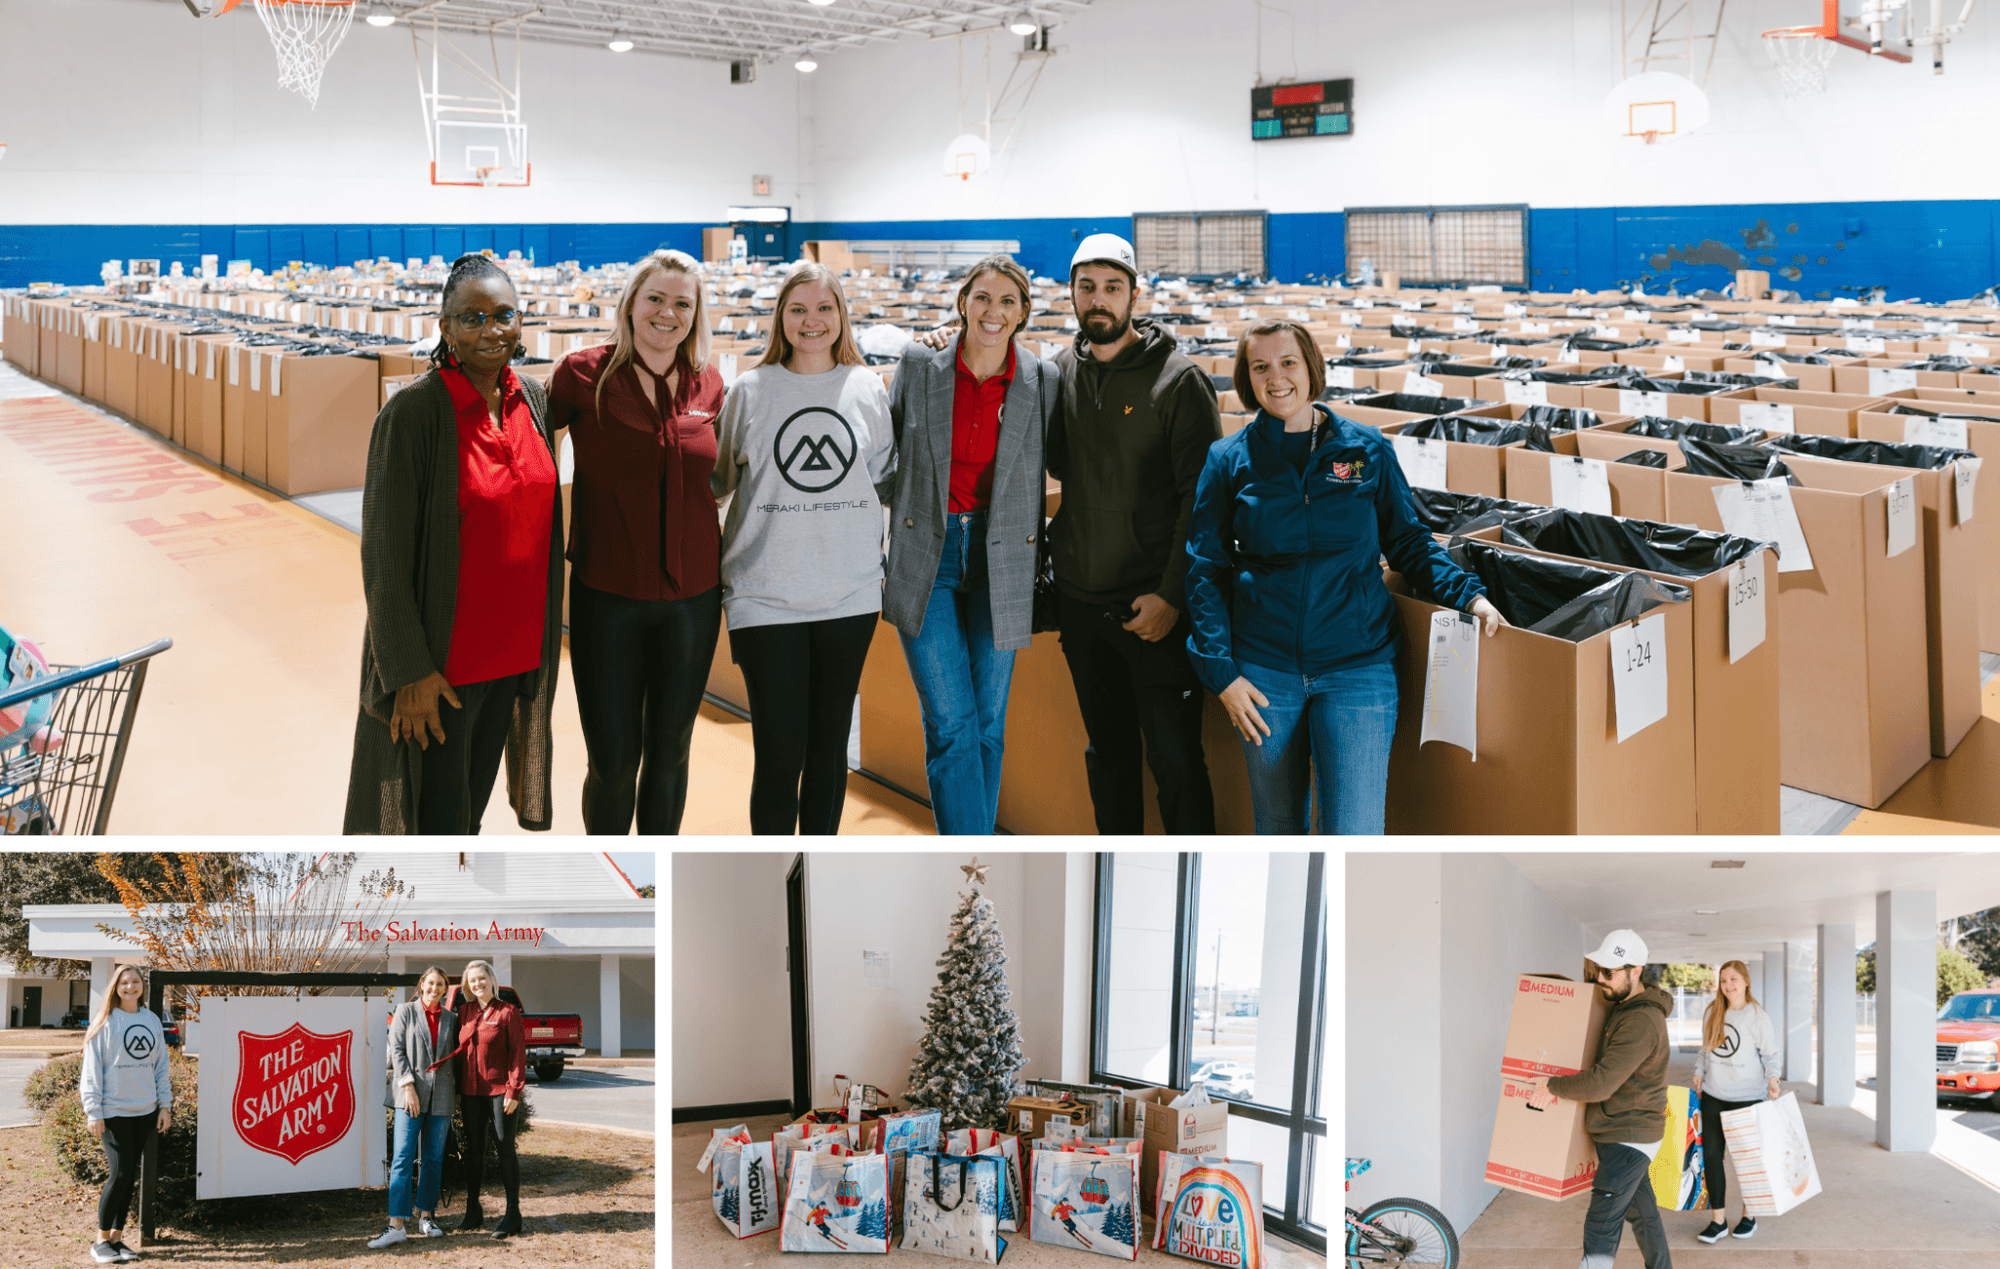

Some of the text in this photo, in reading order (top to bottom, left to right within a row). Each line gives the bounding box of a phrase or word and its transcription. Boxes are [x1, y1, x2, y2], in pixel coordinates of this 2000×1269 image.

[756, 500, 869, 513] MERAKI LIFESTYLE
[1734, 576, 1758, 607] 25-50
[1626, 640, 1652, 673] 1-24
[340, 920, 546, 948] The Salvation Army
[1530, 982, 1575, 998] MEDIUM
[258, 1039, 305, 1083] THE
[242, 1044, 342, 1130] SALVATION
[277, 1082, 339, 1148] ARMY
[1179, 1240, 1241, 1265] DIVIDED
